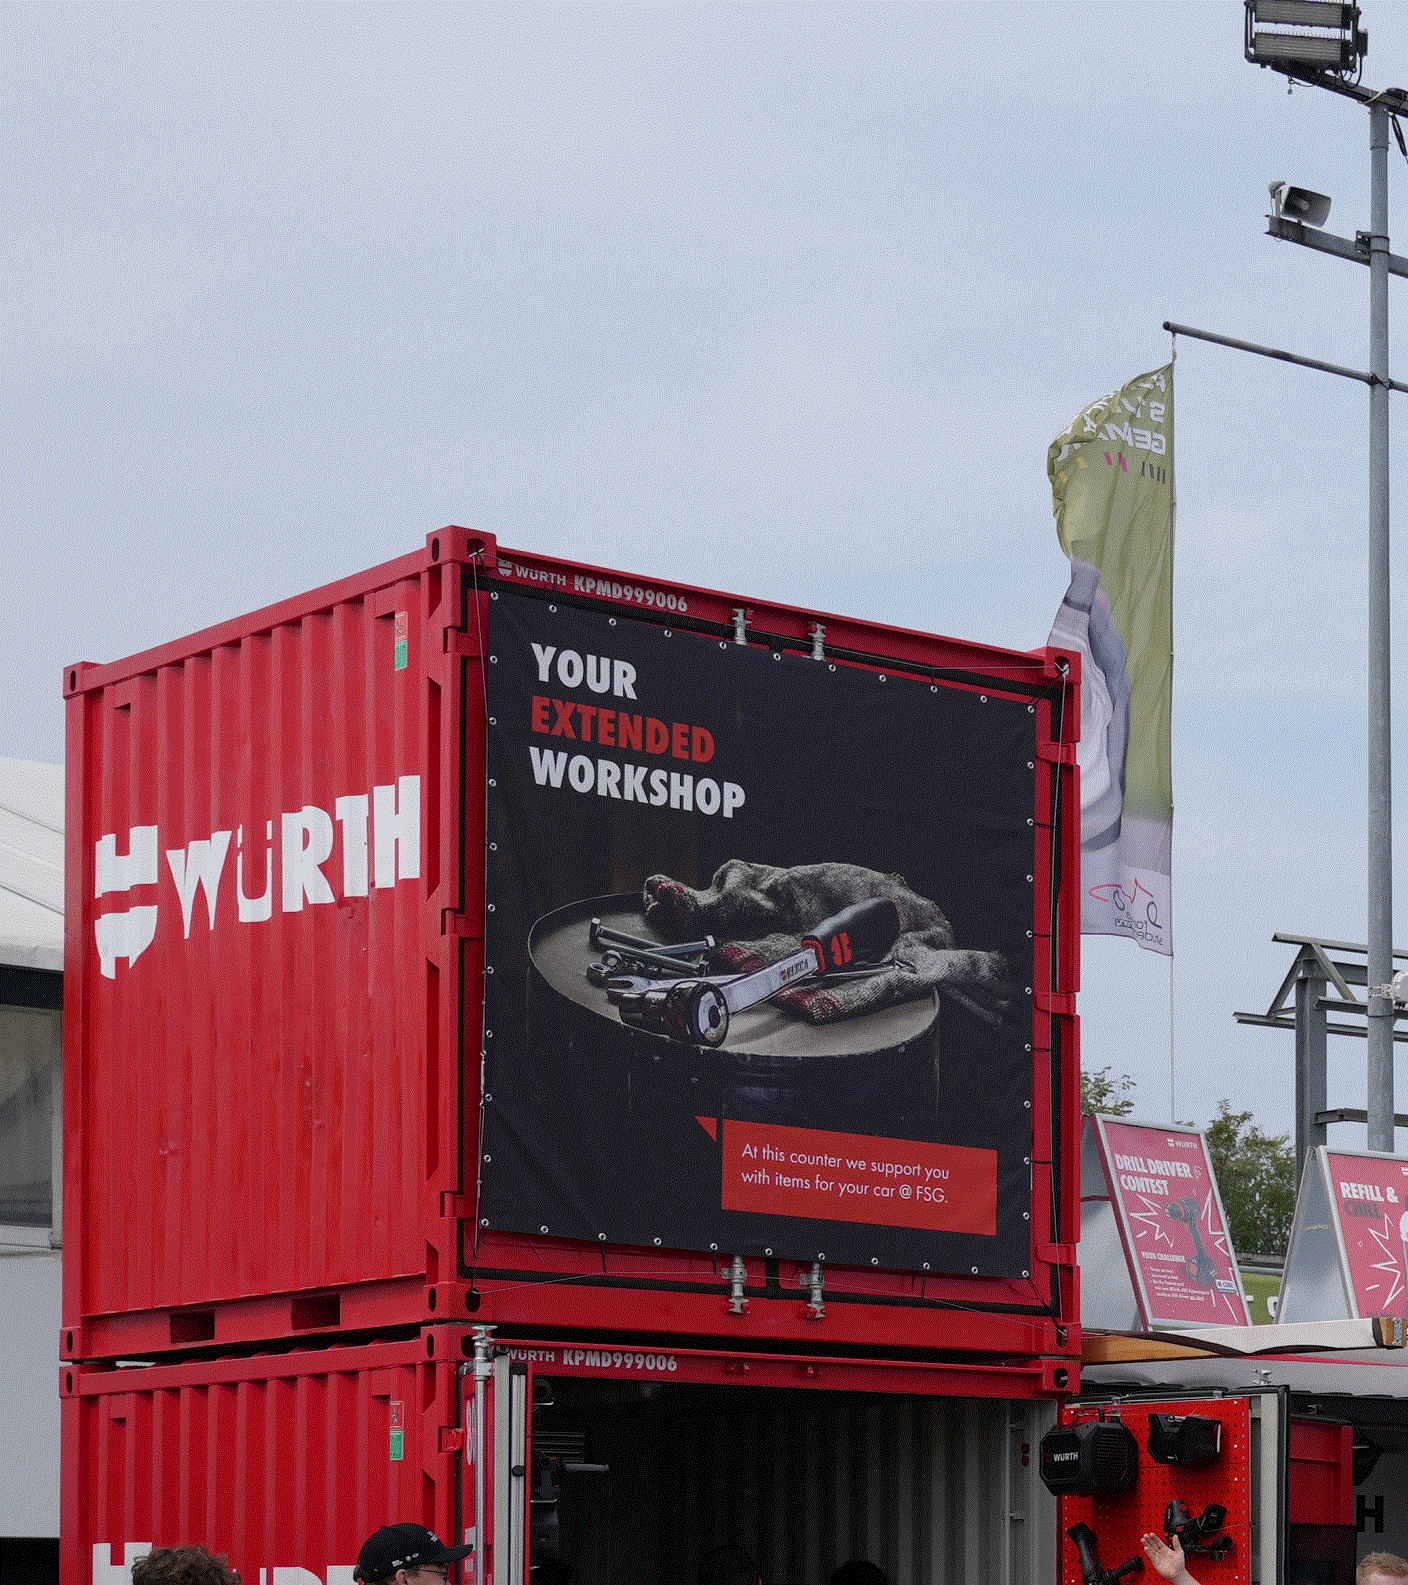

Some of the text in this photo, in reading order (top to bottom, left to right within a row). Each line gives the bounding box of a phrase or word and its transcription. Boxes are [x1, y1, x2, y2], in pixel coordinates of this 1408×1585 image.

[515, 565, 688, 613] WÜRTH KPMD999006
[532, 643, 638, 700] YOUR
[530, 695, 716, 764] EXTENDED
[529, 746, 746, 819] WORKSHOP
[166, 775, 420, 940] WÜRTH
[741, 1143, 950, 1181] At this counter we support you
[1114, 1154, 1193, 1179] DRILL DRIVER
[741, 1168, 948, 1204] with items for your car @ FSG.
[1120, 1174, 1169, 1196] CONTEST
[1339, 1182, 1399, 1203] REFILL &
[1343, 1201, 1382, 1219] CHILL
[563, 1349, 678, 1373] KPMD999006
